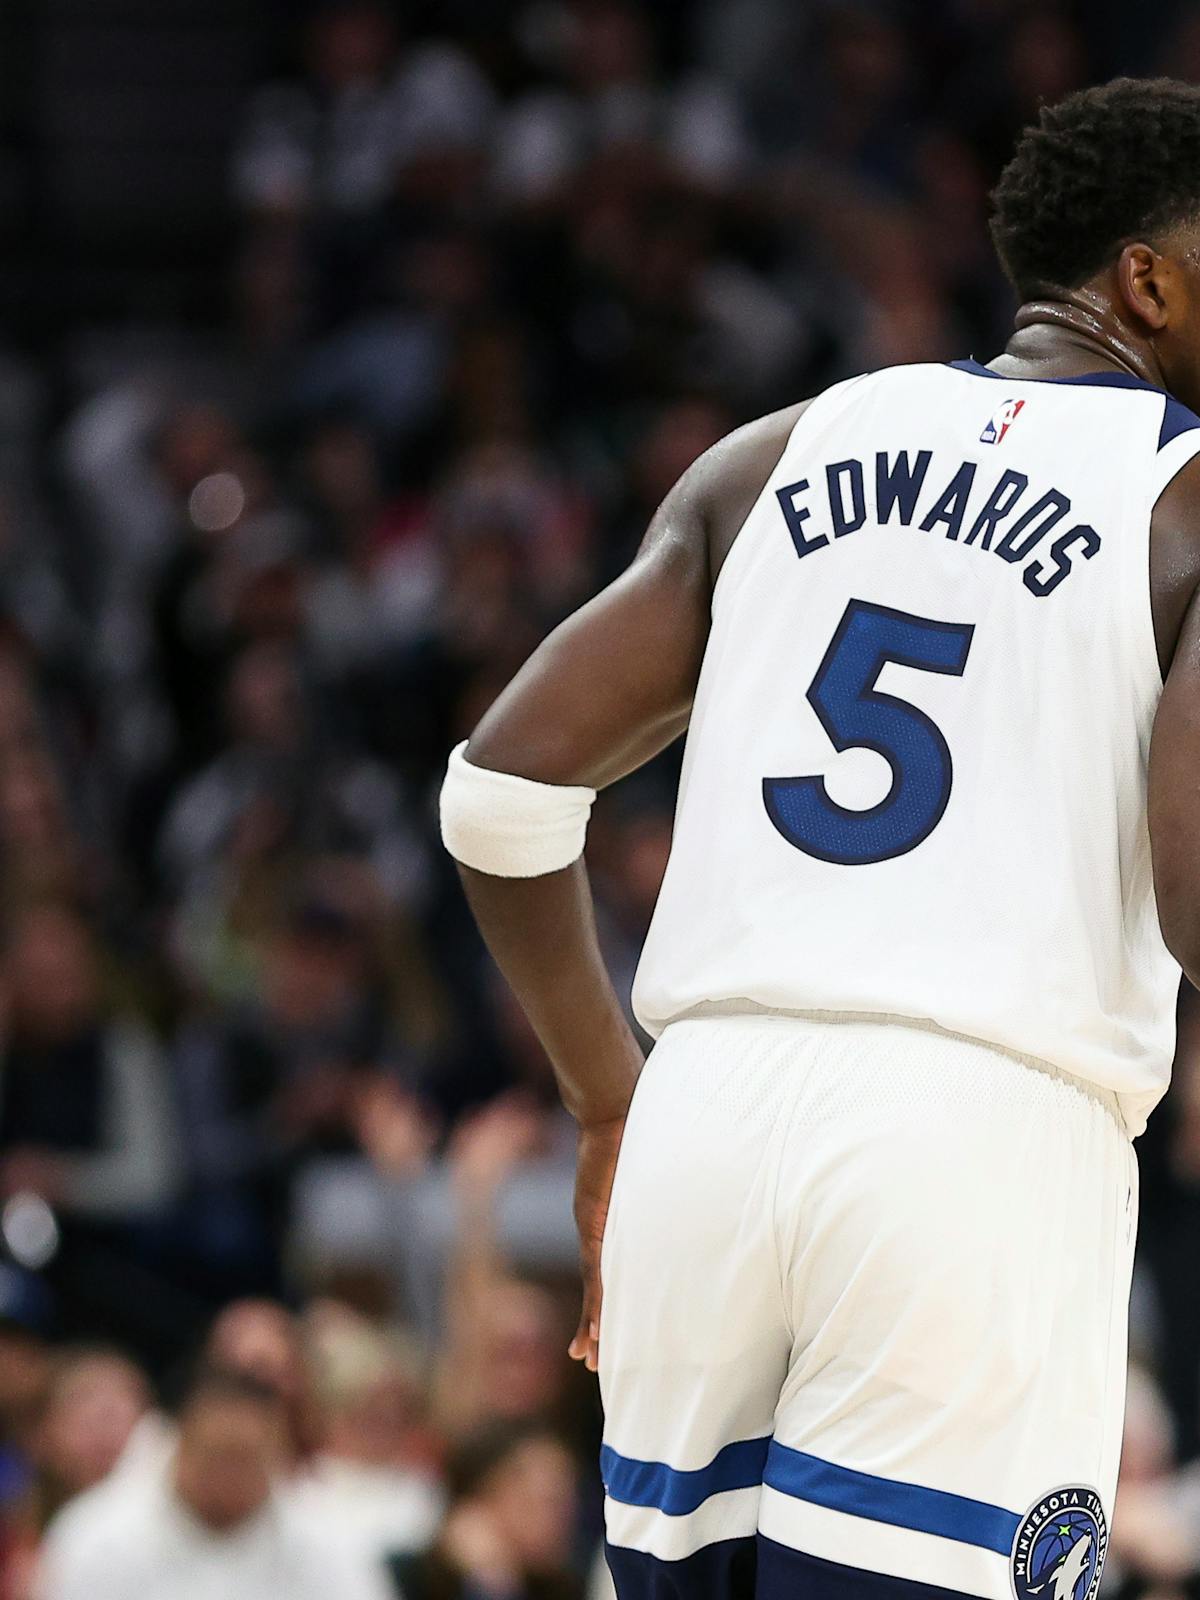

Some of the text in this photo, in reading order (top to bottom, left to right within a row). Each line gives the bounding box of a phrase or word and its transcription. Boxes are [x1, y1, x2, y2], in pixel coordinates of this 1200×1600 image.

[775, 450, 1101, 597] EDWARDS
[762, 597, 976, 866] 5
[1015, 1492, 1079, 1576] MINNESOTA
